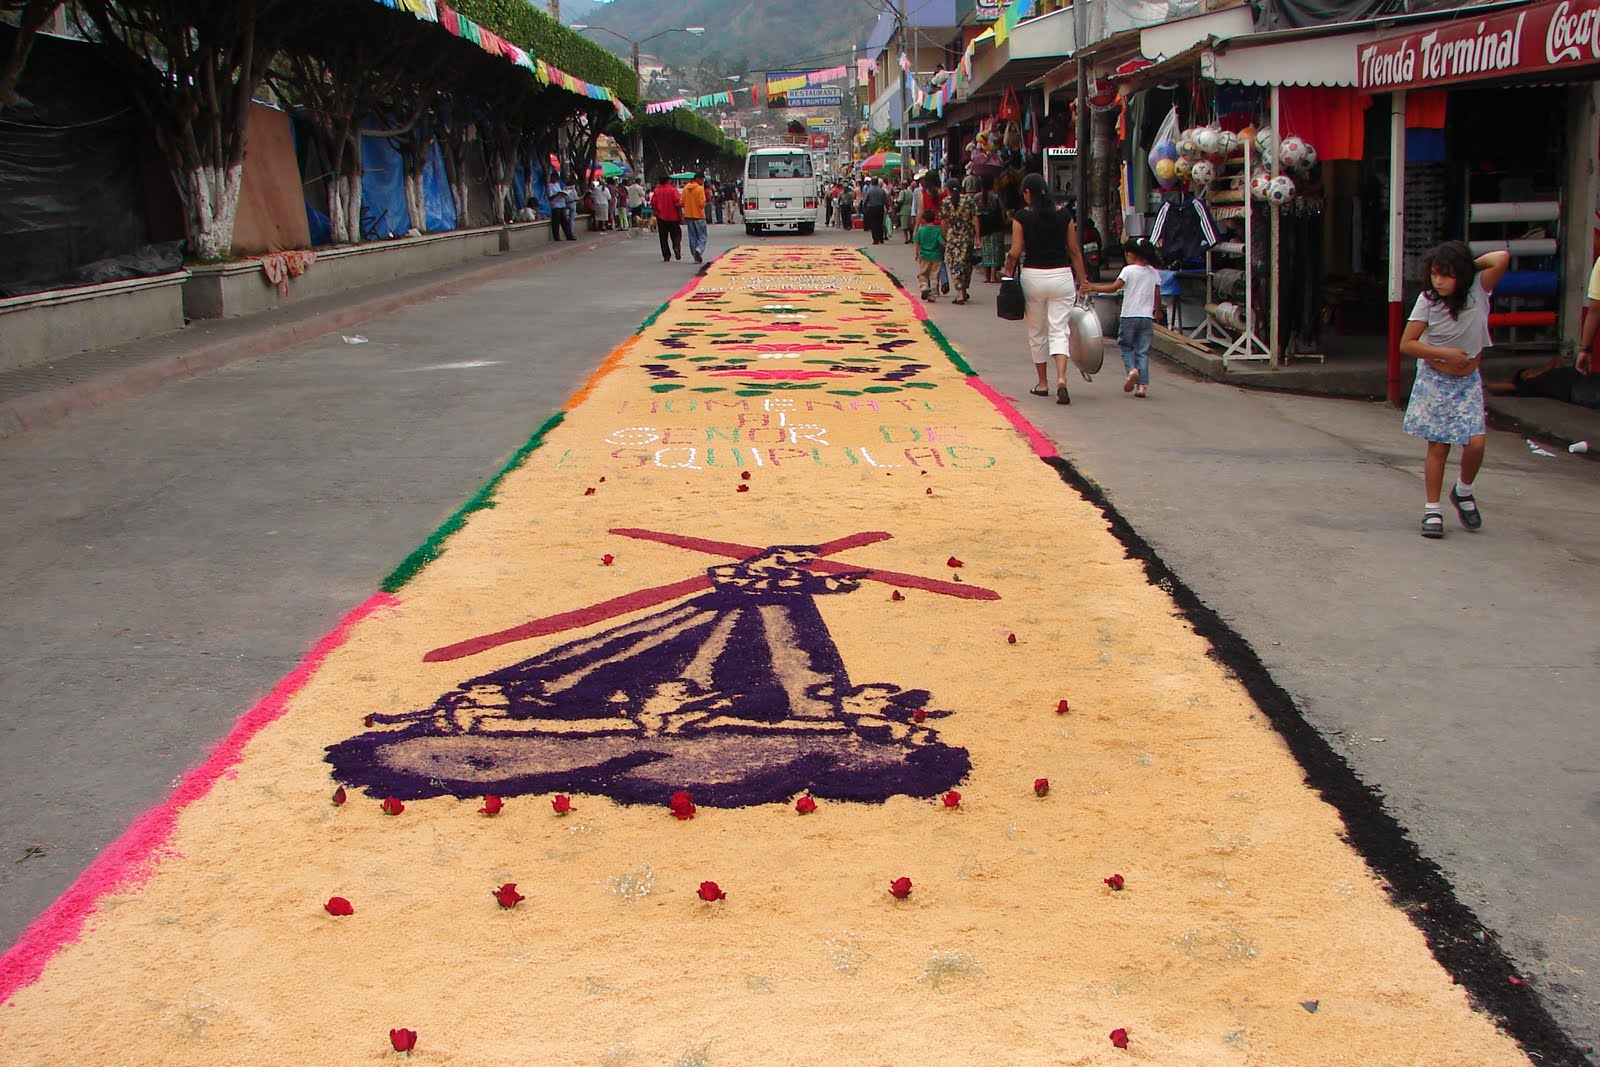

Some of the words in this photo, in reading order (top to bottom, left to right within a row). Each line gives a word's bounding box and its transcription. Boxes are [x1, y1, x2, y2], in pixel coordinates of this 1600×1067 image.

[1361, 39, 1415, 89] Tienda
[1420, 10, 1527, 80] Terminal
[789, 89, 837, 97] RESTAURANT
[802, 98, 840, 106] FRONTERAS
[554, 447, 997, 470] ESQUIPULAS
